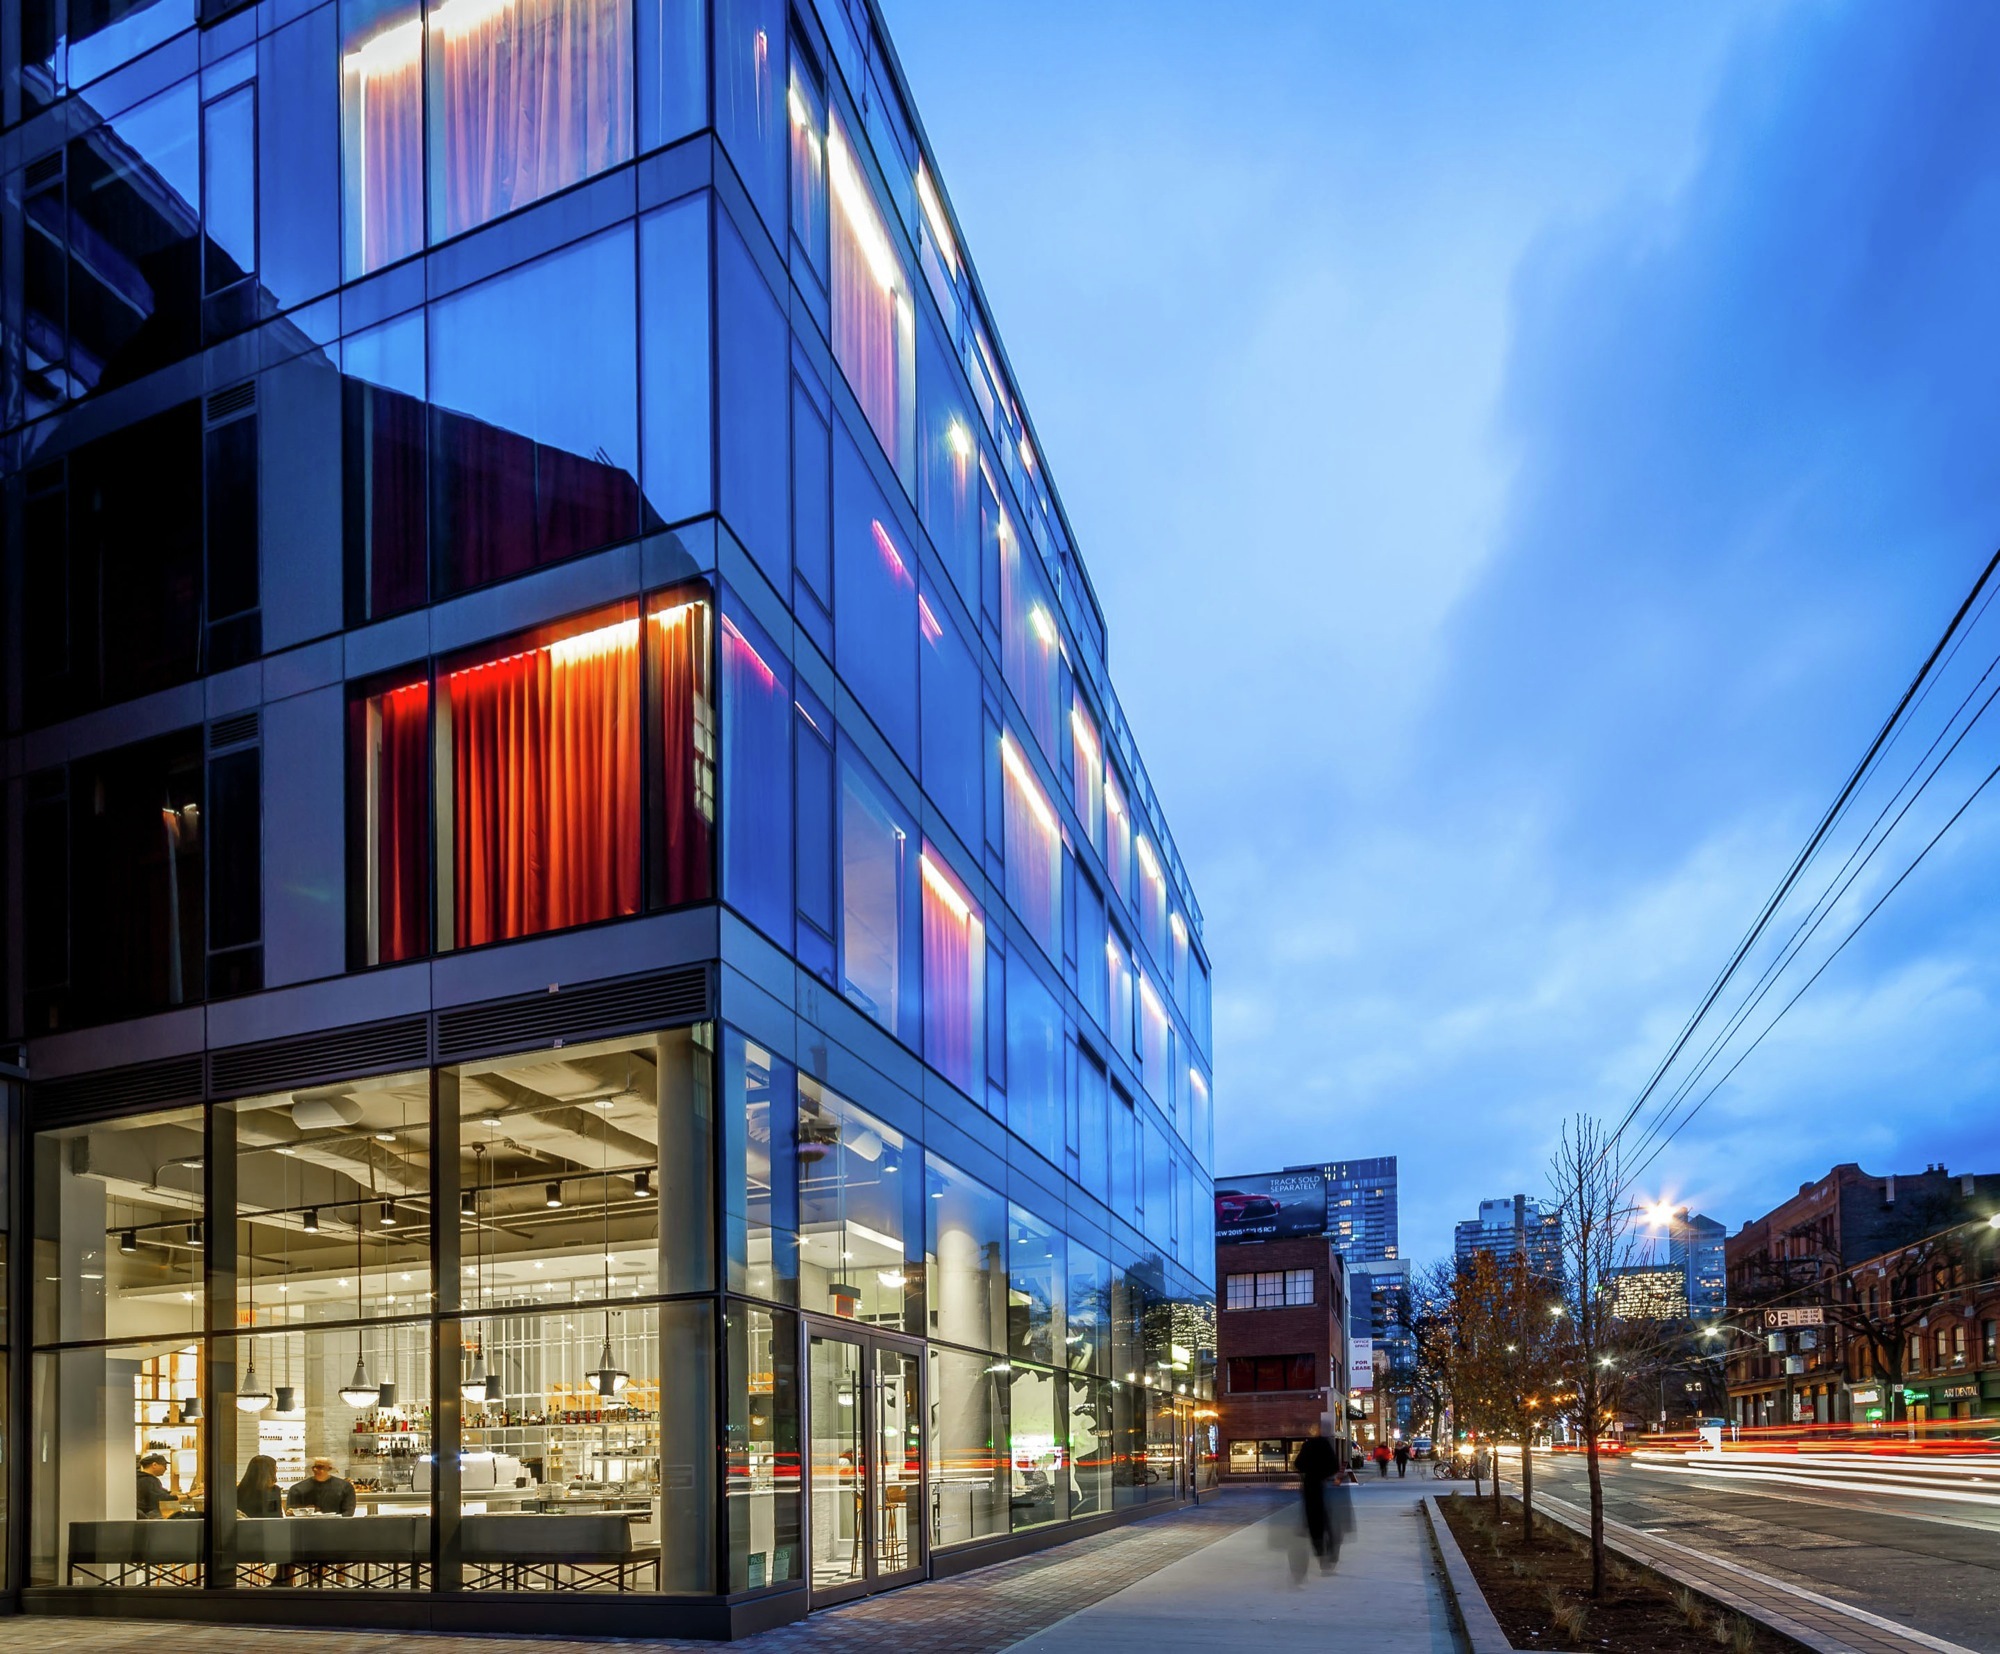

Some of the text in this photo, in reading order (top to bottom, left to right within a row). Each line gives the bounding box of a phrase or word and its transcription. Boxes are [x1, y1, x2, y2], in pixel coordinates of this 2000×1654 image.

[1270, 1175, 1321, 1186] TRACK SOLD
[1955, 1387, 1978, 1396] DENTAL
[776, 1551, 788, 1560] PASS
[750, 1556, 764, 1565] PASS
